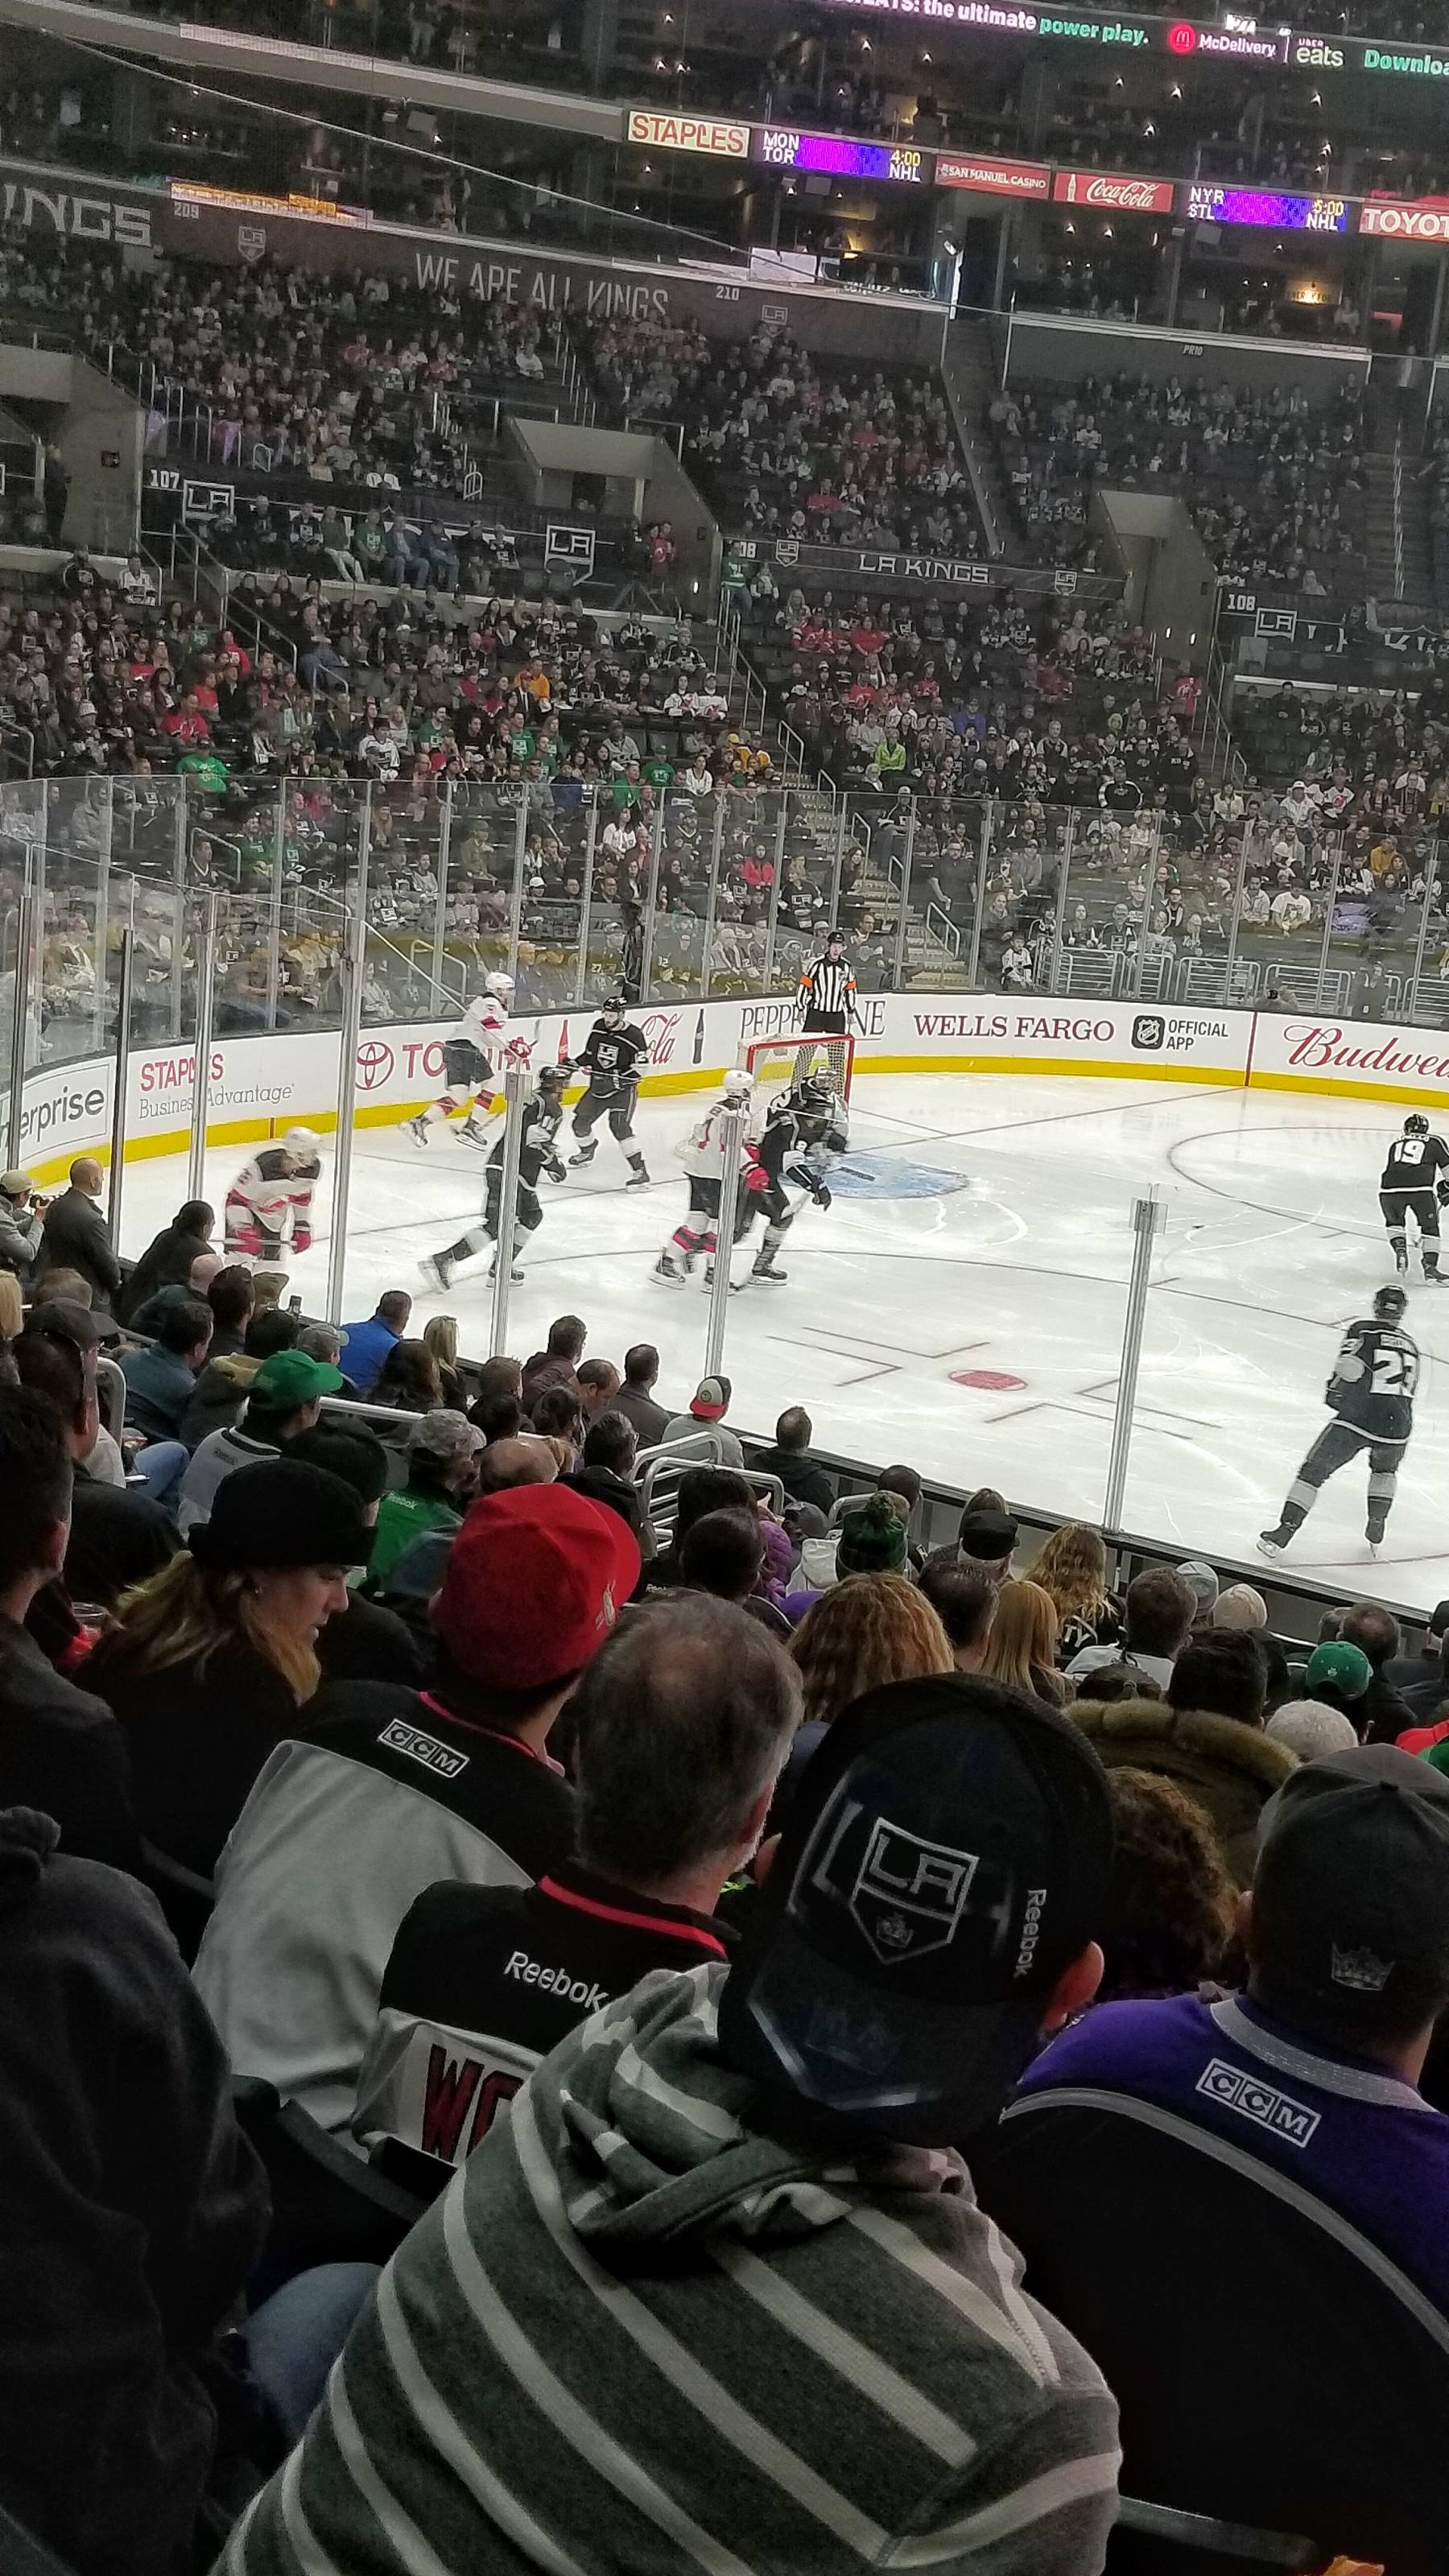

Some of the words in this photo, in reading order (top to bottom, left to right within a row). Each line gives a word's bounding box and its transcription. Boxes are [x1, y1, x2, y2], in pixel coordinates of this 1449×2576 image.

[925, 0, 954, 18] the
[957, 3, 1037, 31] ultimate
[1039, 17, 1098, 39] power
[1102, 23, 1150, 46] play.
[1198, 34, 1277, 56] McDelivery
[1298, 38, 1324, 47] UBER
[1296, 45, 1344, 67] eats
[631, 114, 744, 153] STAPLES
[764, 131, 799, 151] MON
[762, 146, 795, 165] TOR
[890, 149, 921, 167] 4:00
[889, 163, 920, 182] NHL
[948, 166, 967, 178] SAN
[969, 167, 1009, 184] MANUEL
[1010, 175, 1046, 188] CASINO
[1190, 186, 1224, 204] NYR
[174, 200, 200, 220] 209
[1188, 203, 1215, 220] STL
[1307, 213, 1340, 231] NHL
[415, 253, 460, 291] WE
[469, 262, 522, 305] ARE
[588, 279, 669, 321] KINGS
[716, 285, 740, 301] 210
[150, 469, 180, 489] 107
[188, 487, 230, 510] LA
[551, 531, 591, 555] LA
[739, 541, 757, 559] 08
[859, 554, 897, 574] LA
[905, 559, 989, 584] KINGS
[1227, 592, 1257, 612] 108
[1259, 613, 1294, 630] LA
[914, 1015, 1007, 1038] WELLS
[1014, 1017, 1115, 1042] FARGO
[1168, 1019, 1228, 1038] OFFICIAL
[1166, 1036, 1195, 1051] APP
[140, 1053, 224, 1092] STAPLS
[139, 1096, 194, 1120] Busines
[207, 1084, 293, 1108] Advantage
[21, 1085, 105, 1142] erprise
[1393, 1140, 1426, 1165] 19
[382, 1723, 461, 1773] CCM
[869, 1833, 967, 1905] LA
[1013, 1889, 1046, 1979] Reebok
[502, 1951, 609, 2013] Reebok
[420, 2042, 526, 2164] W
[1205, 2067, 1312, 2138] CCM
